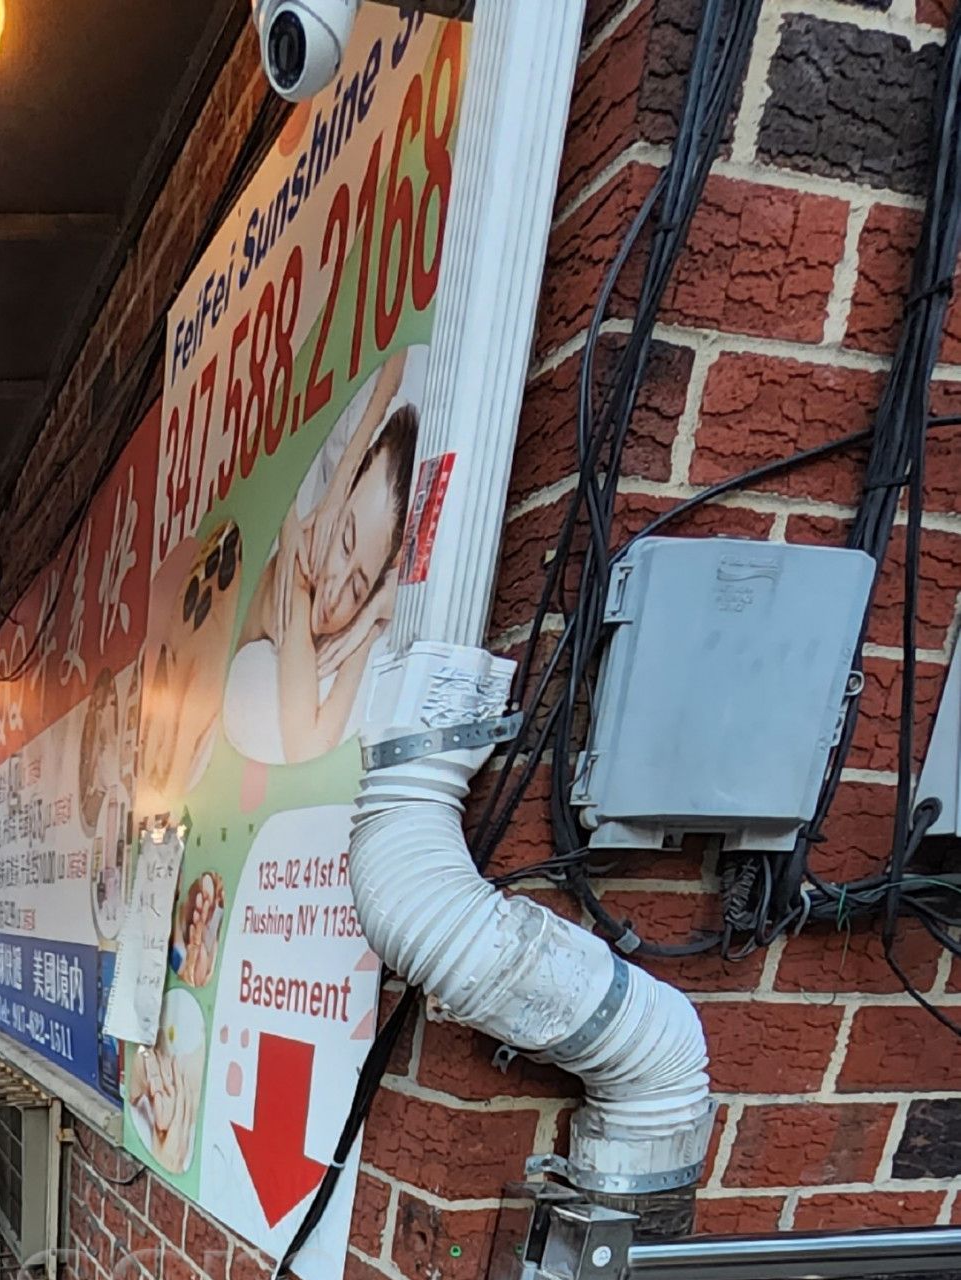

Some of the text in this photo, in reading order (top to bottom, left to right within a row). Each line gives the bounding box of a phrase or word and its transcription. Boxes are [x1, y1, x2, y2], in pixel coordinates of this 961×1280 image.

[239, 38, 382, 290] Sunshine
[161, 20, 463, 547] 347.588.2168
[259, 853, 351, 891] 133-02 41st R
[243, 905, 293, 943] Flushing
[297, 905, 319, 937] NY
[239, 960, 352, 1022] Basement
